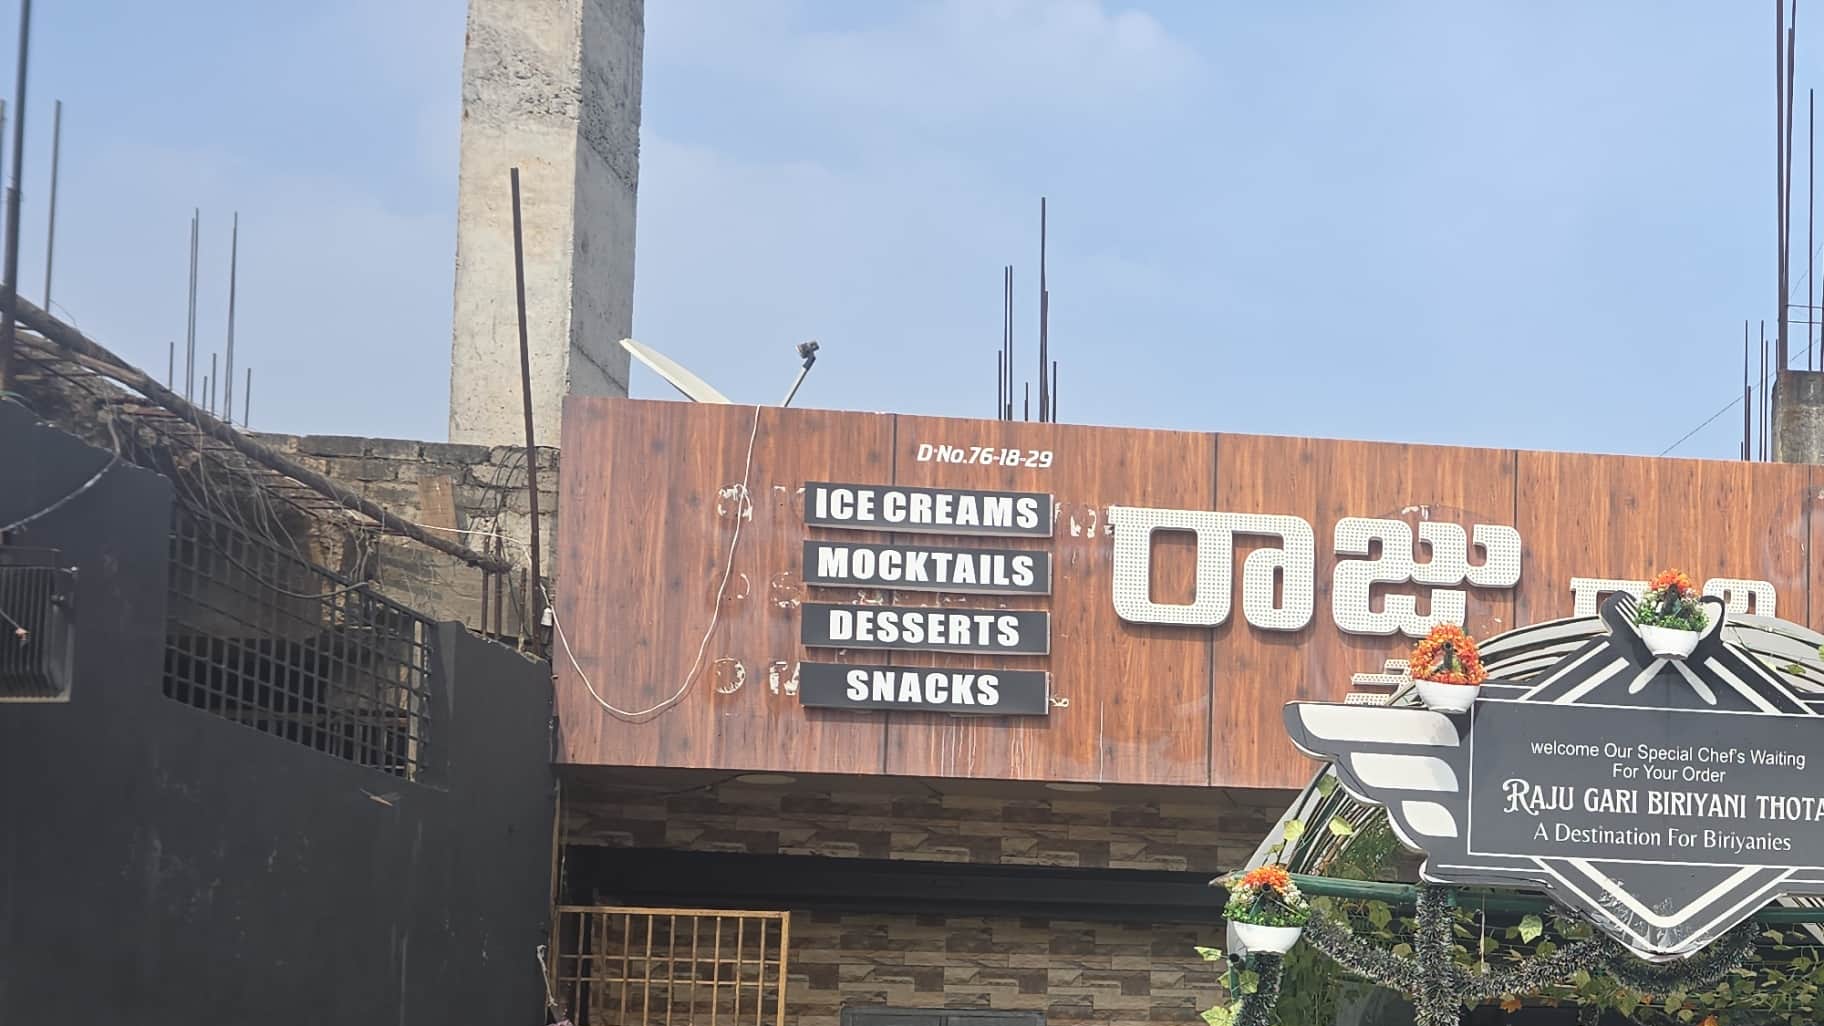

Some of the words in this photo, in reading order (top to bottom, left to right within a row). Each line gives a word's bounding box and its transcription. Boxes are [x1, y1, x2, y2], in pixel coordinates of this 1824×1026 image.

[814, 487, 876, 522] ICE
[883, 489, 1040, 530] CREAMS
[816, 546, 1035, 588] MOCKTAILS
[828, 609, 1021, 648] DESSERTS
[845, 669, 1000, 706] SNACKS
[1531, 741, 1599, 758] welcome
[1604, 743, 1633, 760] Our
[1637, 744, 1693, 764] Special
[1698, 747, 1746, 766] Chef's
[1750, 750, 1806, 770] Waiting
[1613, 764, 1640, 779] For
[1643, 765, 1679, 781] Your
[1682, 766, 1726, 784] Order
[1583, 787, 1638, 814] GARI
[1647, 790, 1747, 819] BIRIYANI
[1533, 823, 1549, 841] A
[1554, 823, 1661, 848] Destination
[1668, 828, 1698, 849] For
[1703, 830, 1792, 856] Biriyanies
